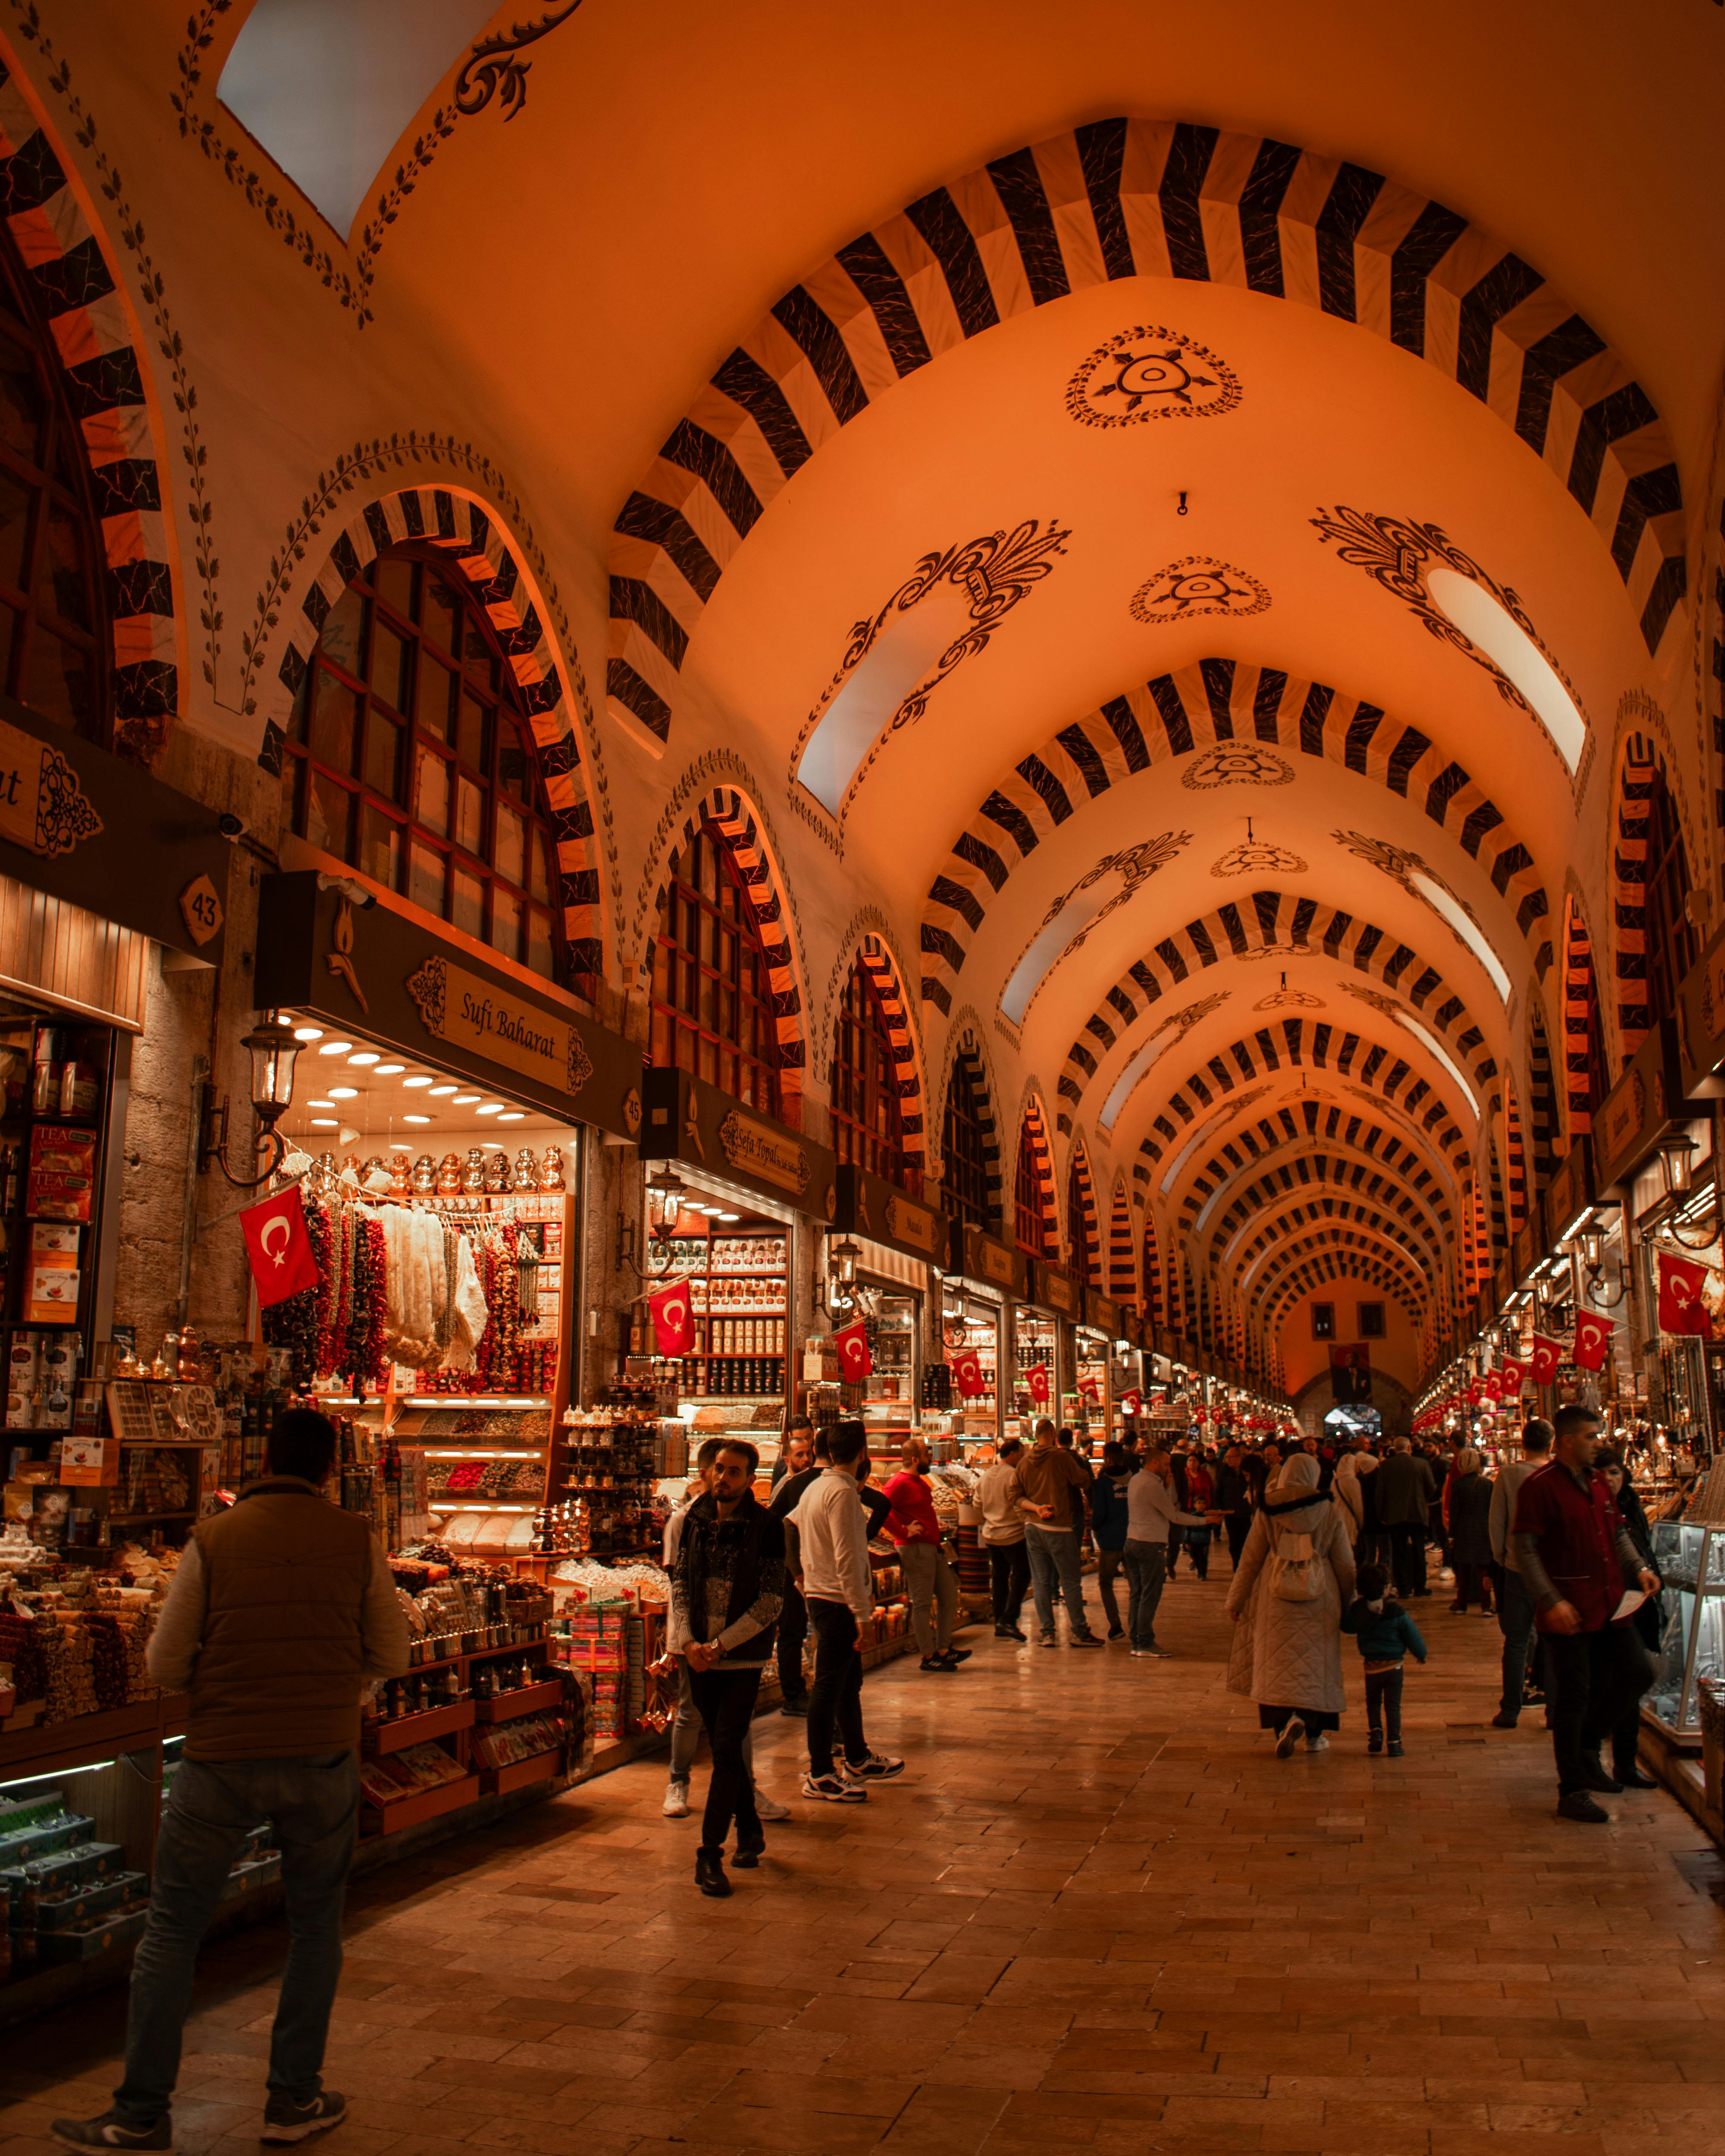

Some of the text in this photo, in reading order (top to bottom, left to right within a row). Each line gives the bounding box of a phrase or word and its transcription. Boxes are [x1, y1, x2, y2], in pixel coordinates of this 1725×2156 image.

[192, 893, 216, 927] 43
[461, 993, 555, 1059] Sufi Baharat
[629, 1100, 639, 1121] 45
[38, 1127, 67, 1141] TEA
[738, 1128, 754, 1157] Sefa
[756, 1138, 778, 1166] Topal
[34, 1173, 63, 1187] TEA
